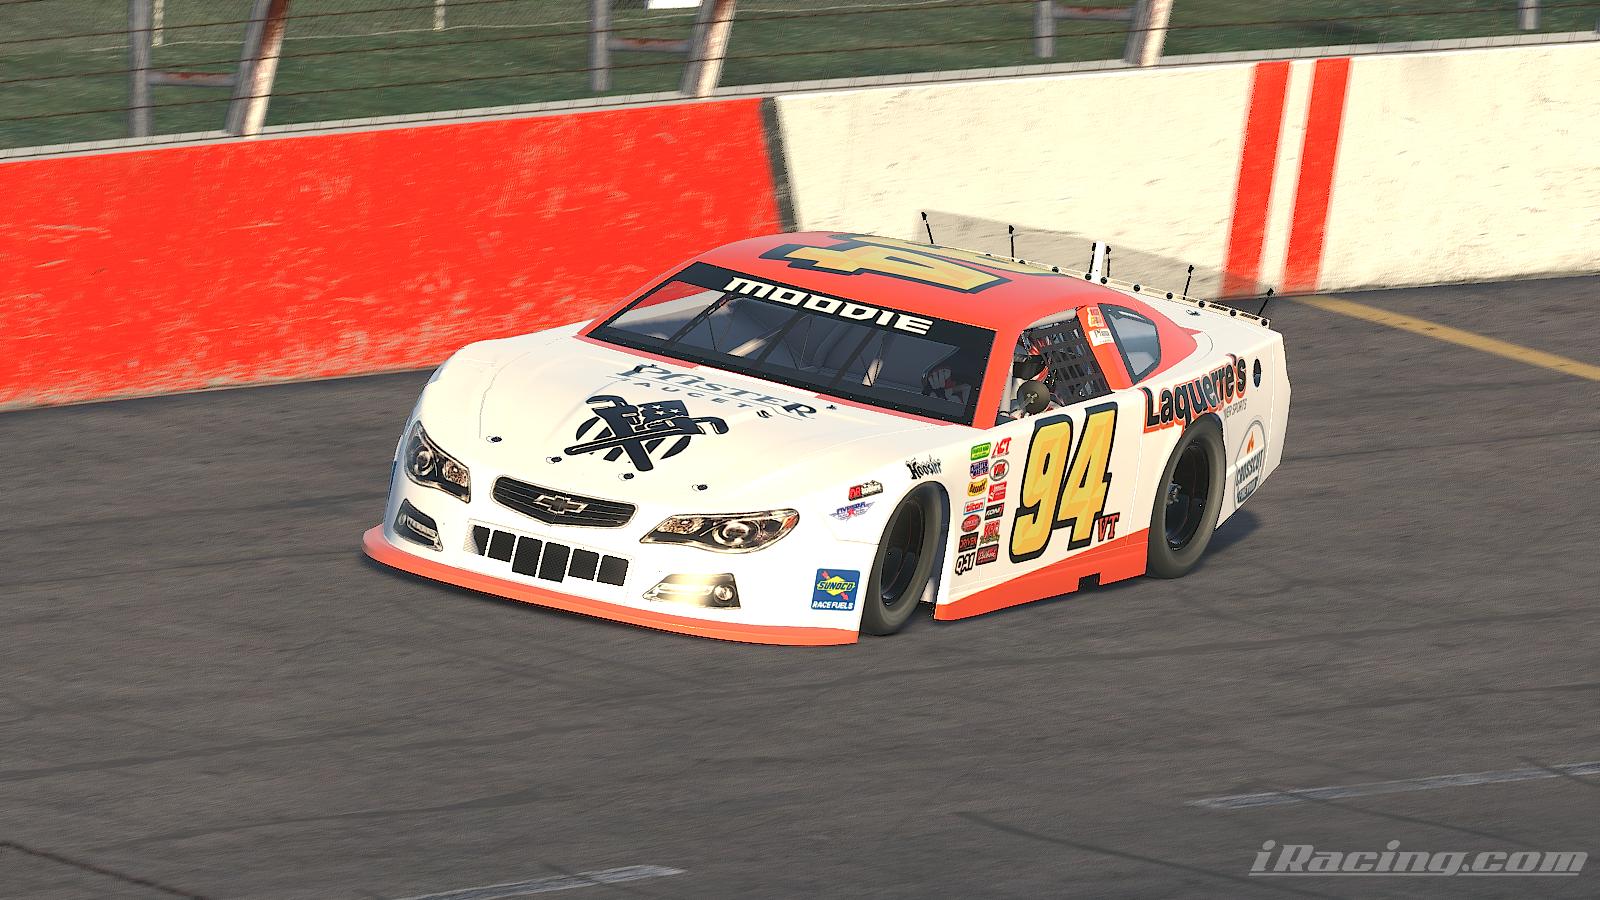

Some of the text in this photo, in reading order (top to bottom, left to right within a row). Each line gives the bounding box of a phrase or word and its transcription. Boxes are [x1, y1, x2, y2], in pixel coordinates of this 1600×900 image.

[724, 276, 933, 335] MOODIE
[1143, 353, 1246, 432] Laquerre's
[1009, 402, 1118, 563] 94
[1098, 512, 1120, 542] VT
[812, 600, 854, 609] RACE FUELS
[817, 581, 856, 590] SUNOCO
